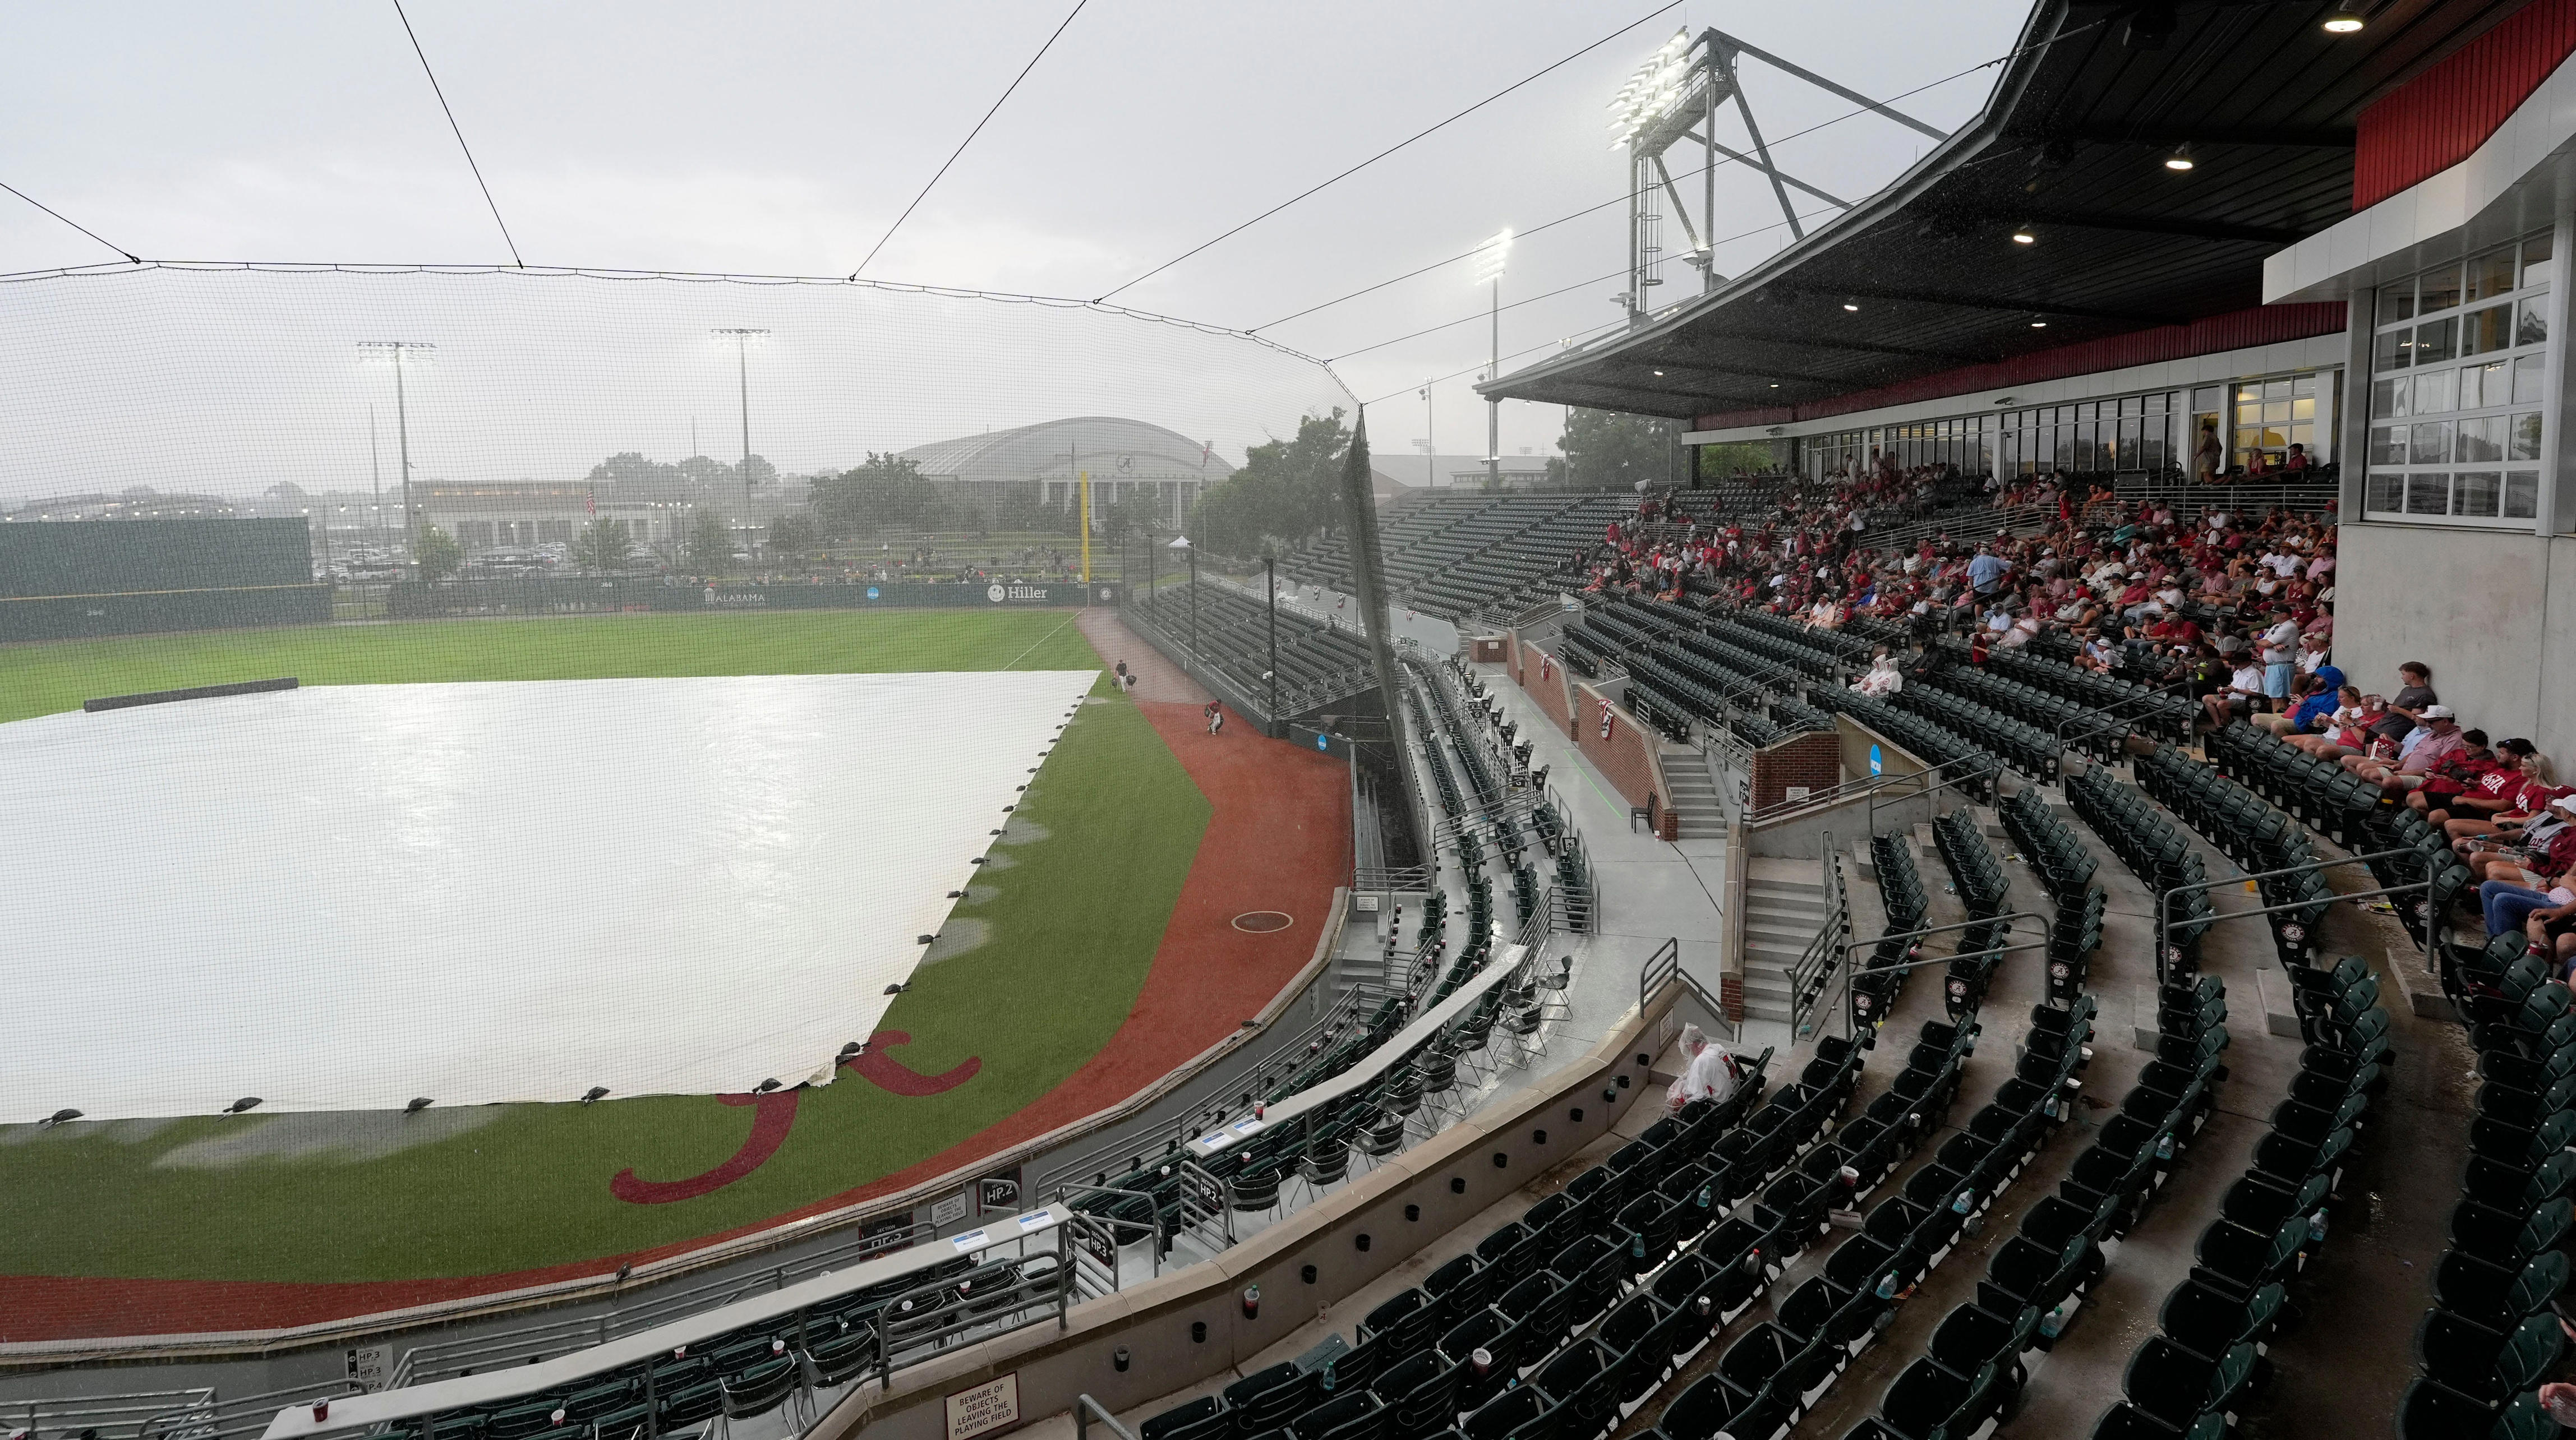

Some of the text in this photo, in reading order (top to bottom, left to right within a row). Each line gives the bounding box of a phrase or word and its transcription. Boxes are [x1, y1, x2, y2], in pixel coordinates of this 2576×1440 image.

[715, 594, 765, 602] ALABAMA
[1008, 587, 1048, 599] Hiller
[987, 1184, 1013, 1203] HP.2
[1200, 1183, 1216, 1203] HP.2
[937, 1201, 953, 1210] BEWARE
[941, 1203, 957, 1213] OBJECTS
[935, 1215, 952, 1225] PLAYING
[937, 1210, 953, 1220] LEAVING
[877, 1225, 896, 1234] SECTION
[1091, 1230, 1105, 1244] SECTION
[1091, 1237, 1107, 1257] HP.3
[360, 1351, 380, 1361] HP.3
[361, 1367, 381, 1377] HP.3
[960, 1384, 1004, 1406] BEWARE OF
[966, 1395, 998, 1413] OBJECTS
[958, 1401, 1008, 1425] LEAVING THE
[955, 1409, 1011, 1436] PLAYING FIELD
